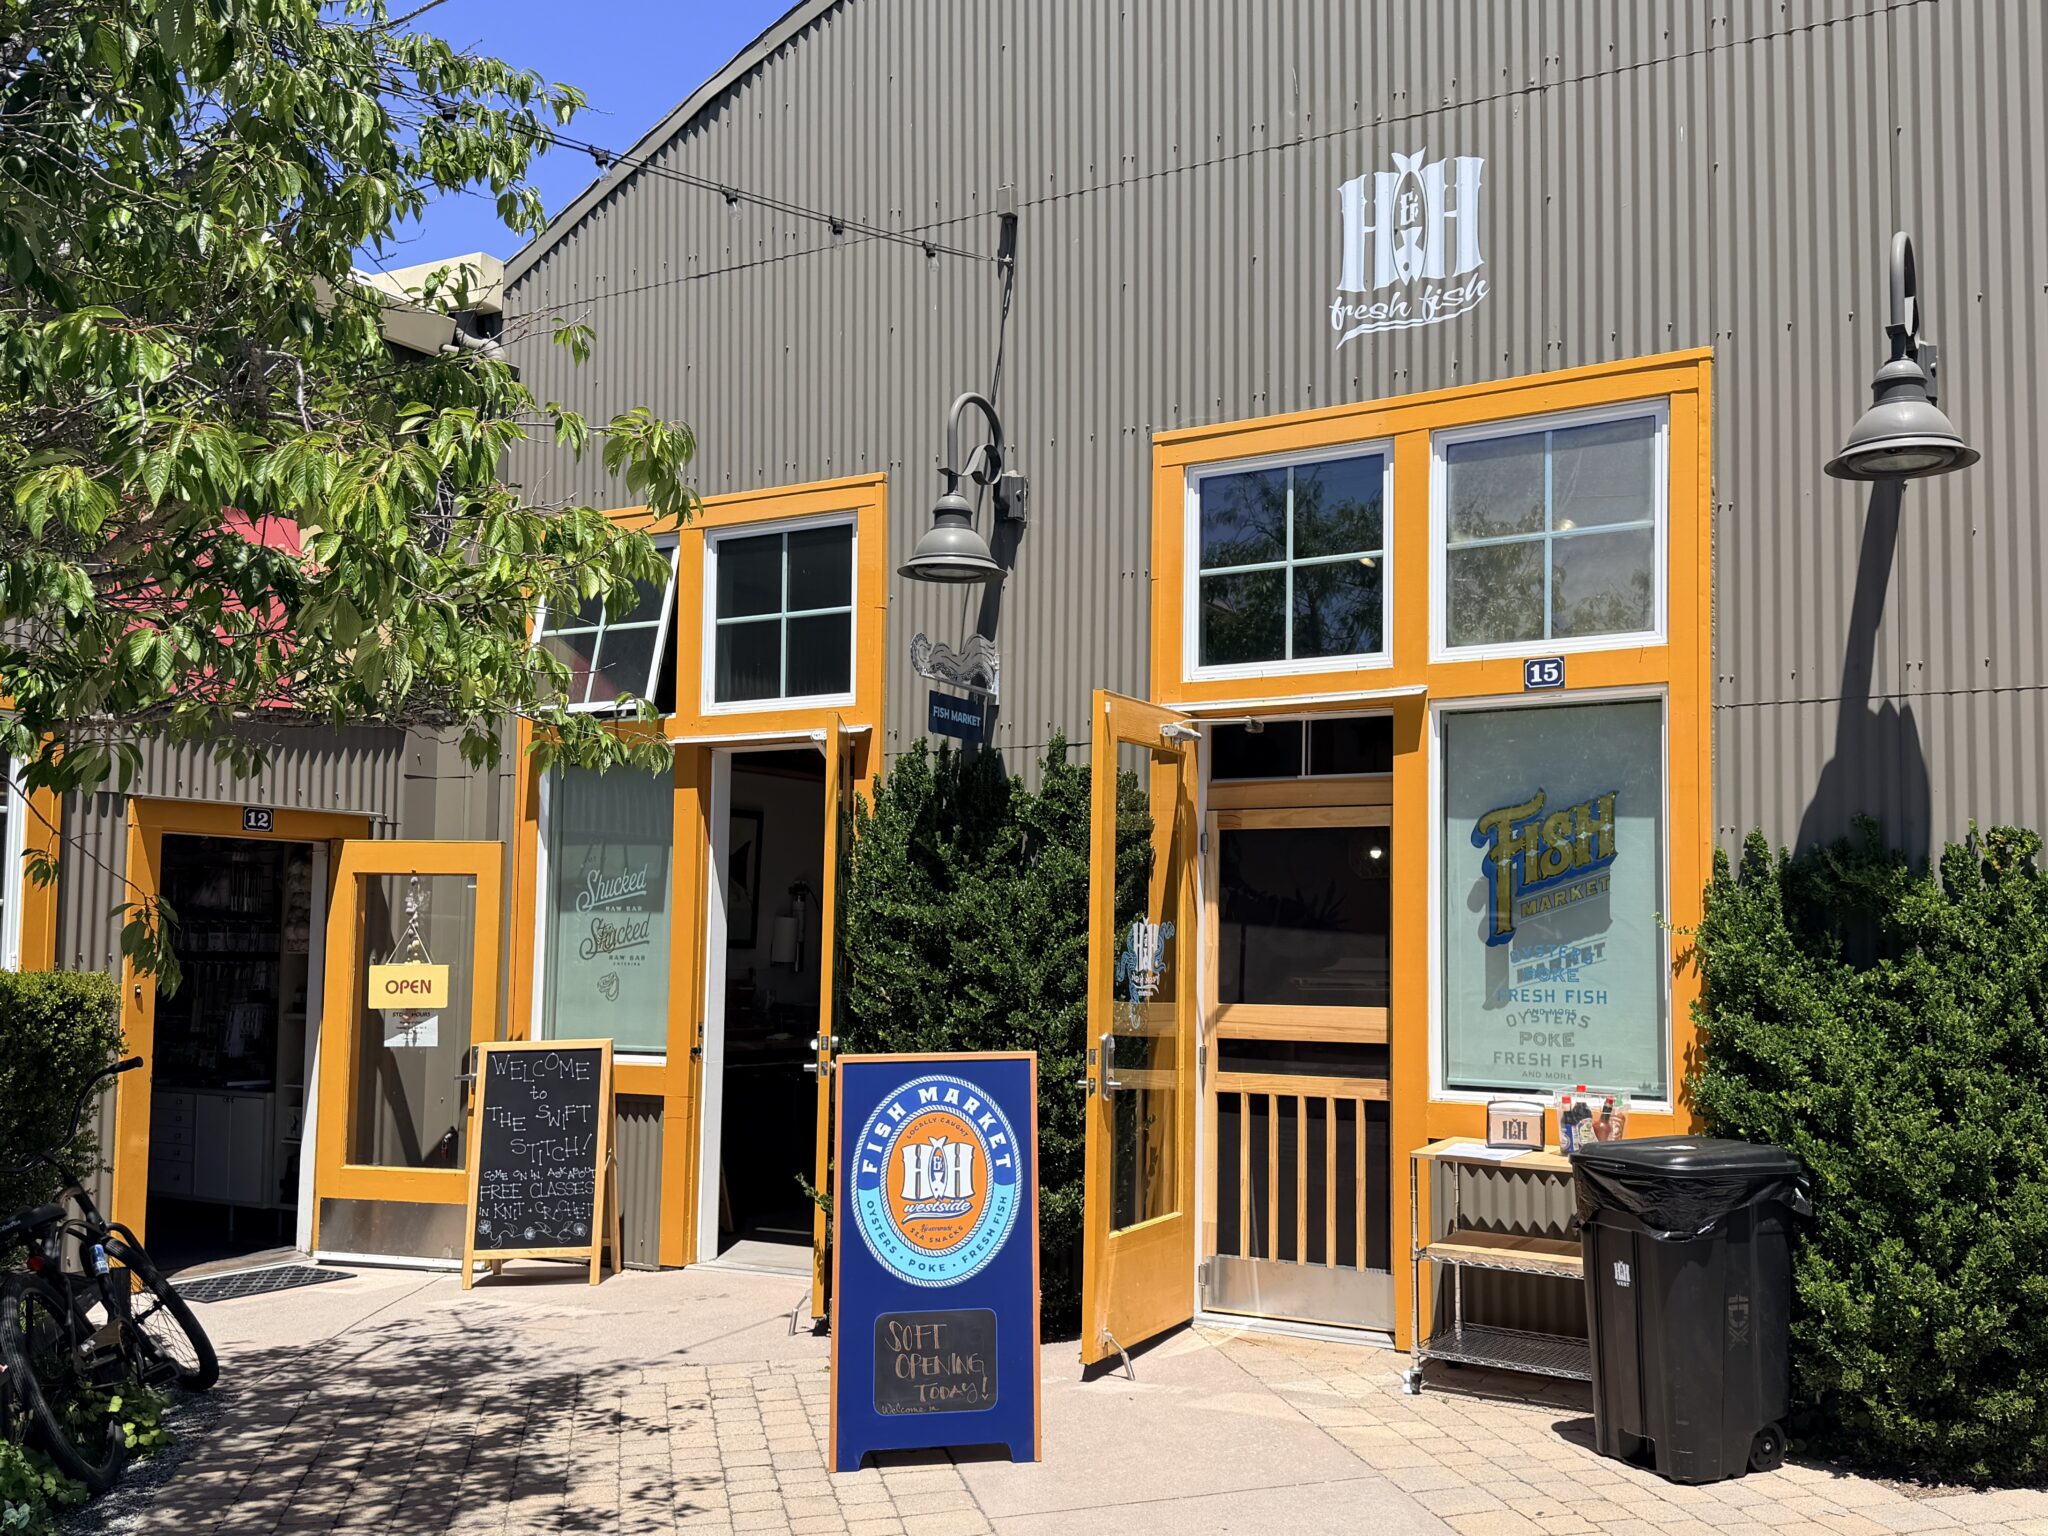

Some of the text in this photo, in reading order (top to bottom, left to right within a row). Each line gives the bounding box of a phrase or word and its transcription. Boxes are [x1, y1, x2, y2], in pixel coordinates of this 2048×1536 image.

[1329, 273, 1490, 330] fresh fish
[1530, 663, 1558, 682] 15
[933, 705, 981, 728] FISH MARKET
[248, 812, 268, 827] 12
[576, 864, 648, 913] Shucked
[1520, 875, 1610, 918] MARKET
[1509, 944, 1595, 965] OYSTERS
[385, 980, 432, 994] OPEN
[1498, 989, 1607, 1004] FRESH FISH
[1506, 1010, 1591, 1029] OYSTERS
[1519, 1031, 1575, 1048] POKE
[492, 1052, 590, 1082] WELCOME
[1493, 1051, 1602, 1069] FRESH FISH
[1522, 1070, 1573, 1081] AND MORE
[529, 1086, 547, 1100] to
[486, 1104, 591, 1131] THE SWIFT
[862, 1086, 1011, 1174] FISH MARKET
[906, 1117, 969, 1139] LOCALLY CAUGHT
[510, 1133, 592, 1165] STITCH!
[483, 1169, 508, 1181] COME
[512, 1169, 527, 1180] ON
[547, 1167, 567, 1178] ASK
[567, 1166, 596, 1179] ABOUT
[480, 1181, 594, 1201] FREE CLASSES
[479, 1206, 489, 1216] IN
[494, 1202, 525, 1220] KNIT
[534, 1200, 594, 1222] CROCHET
[903, 1199, 973, 1214] westside
[867, 1196, 1007, 1272] OYSTERS POKE FRESH FISH
[910, 1225, 963, 1243] SEA SNACKS
[885, 1321, 948, 1352] SOFT
[895, 1353, 986, 1379] OPENING
[882, 1403, 924, 1415] Welcome
